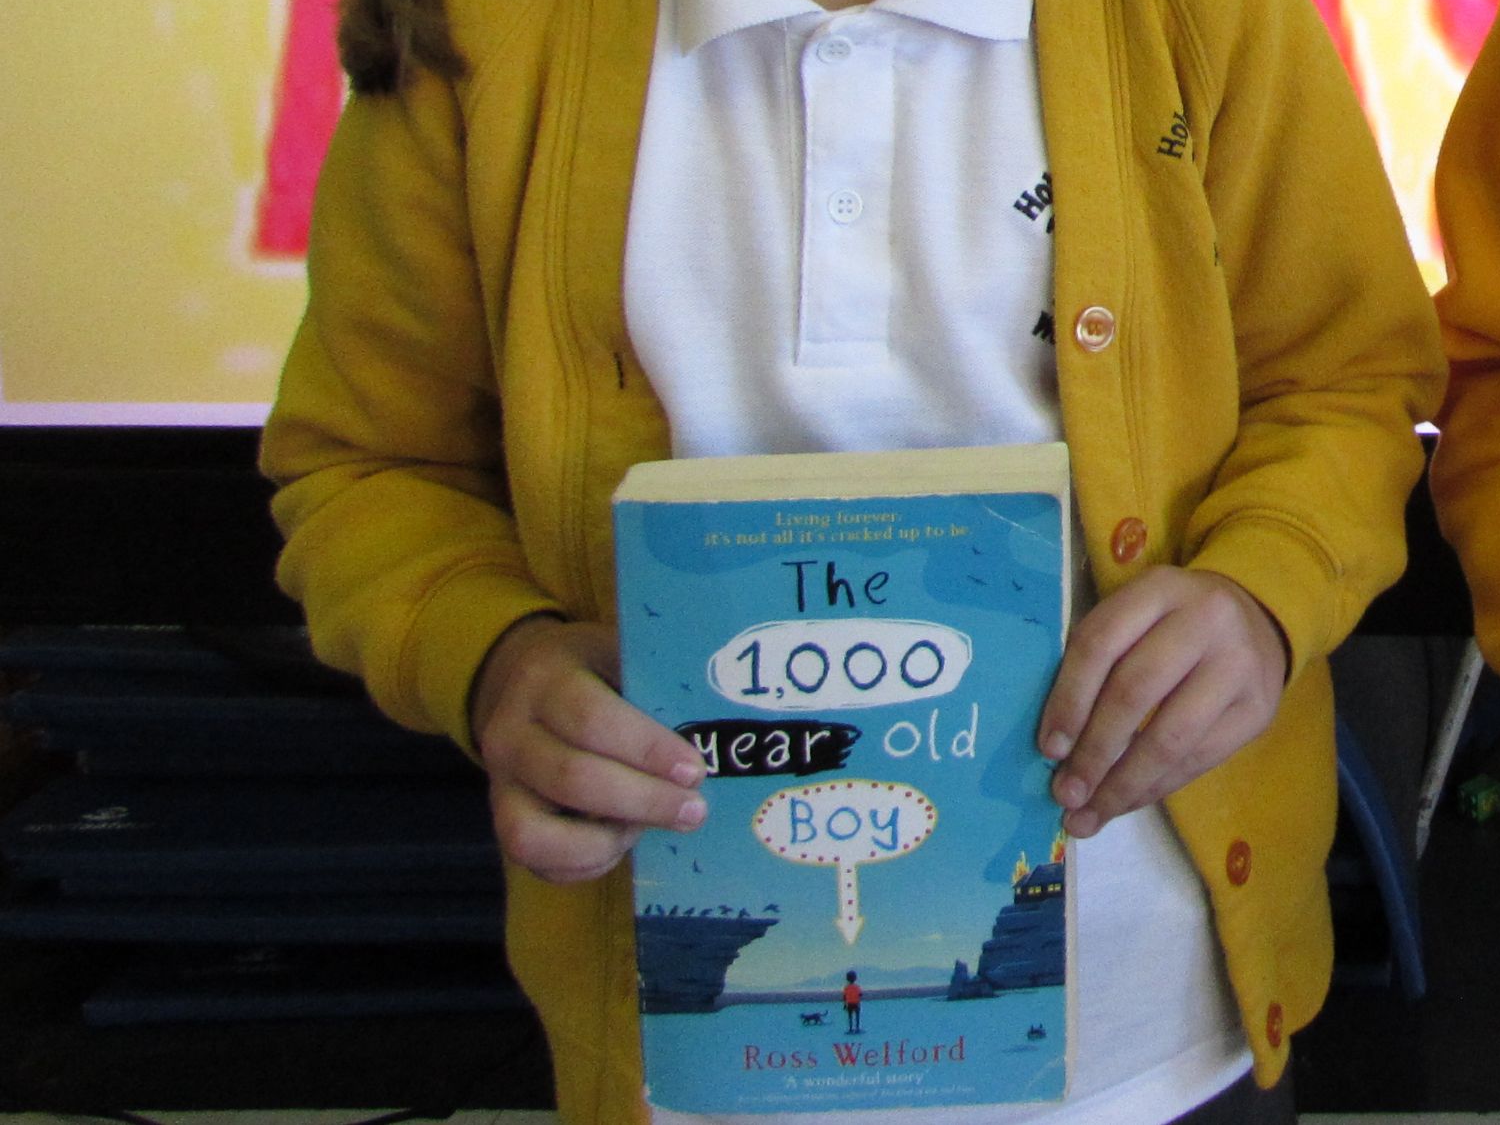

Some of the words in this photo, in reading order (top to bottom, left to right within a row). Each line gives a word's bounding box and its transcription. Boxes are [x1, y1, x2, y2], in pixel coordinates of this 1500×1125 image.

[704, 530, 731, 546] it's
[736, 531, 768, 545] not
[773, 531, 794, 544] all
[800, 530, 825, 544] it's
[830, 527, 893, 543] cracked
[899, 528, 919, 543] up
[926, 525, 944, 537] to
[776, 512, 830, 527] Living
[781, 559, 890, 614] The
[736, 640, 945, 698] 1,000
[693, 730, 831, 773] year
[884, 702, 979, 762] old
[742, 1044, 818, 1071] Ross
[832, 1035, 966, 1068] Welford
[803, 1071, 881, 1087] wonderful
